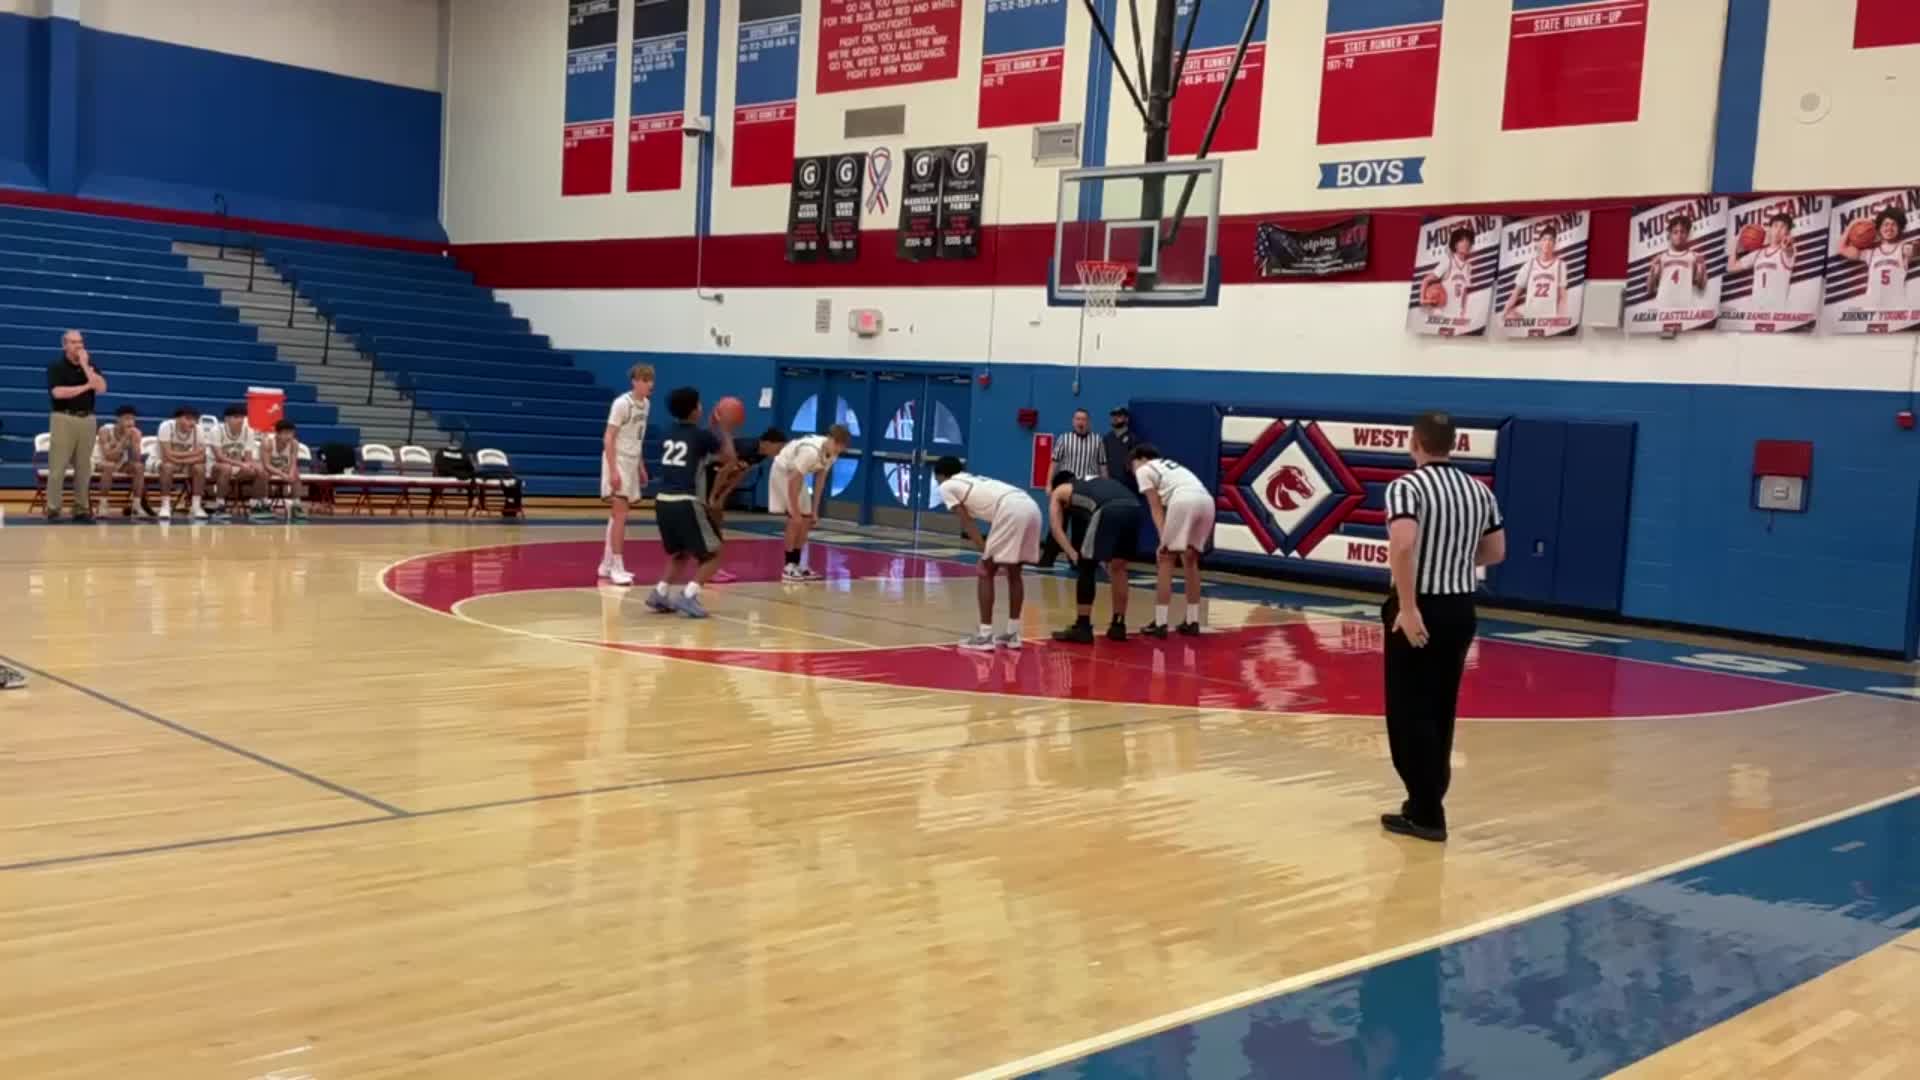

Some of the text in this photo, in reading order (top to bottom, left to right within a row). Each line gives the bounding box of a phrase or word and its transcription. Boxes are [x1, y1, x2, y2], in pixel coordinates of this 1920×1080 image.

[1534, 10, 1623, 33] STATE RUNNER-UP
[1344, 34, 1420, 53] STATE RUNNER-UP
[840, 163, 852, 182] G
[916, 156, 929, 176] G
[956, 152, 969, 173] G
[804, 165, 816, 184] G
[1336, 161, 1404, 186] BOYS
[1670, 270, 1679, 285] 4
[1881, 270, 1890, 285] 5
[1535, 283, 1550, 297] 22
[1353, 427, 1409, 448] WEST
[661, 440, 688, 466] 22
[1347, 542, 1389, 563] MUS
